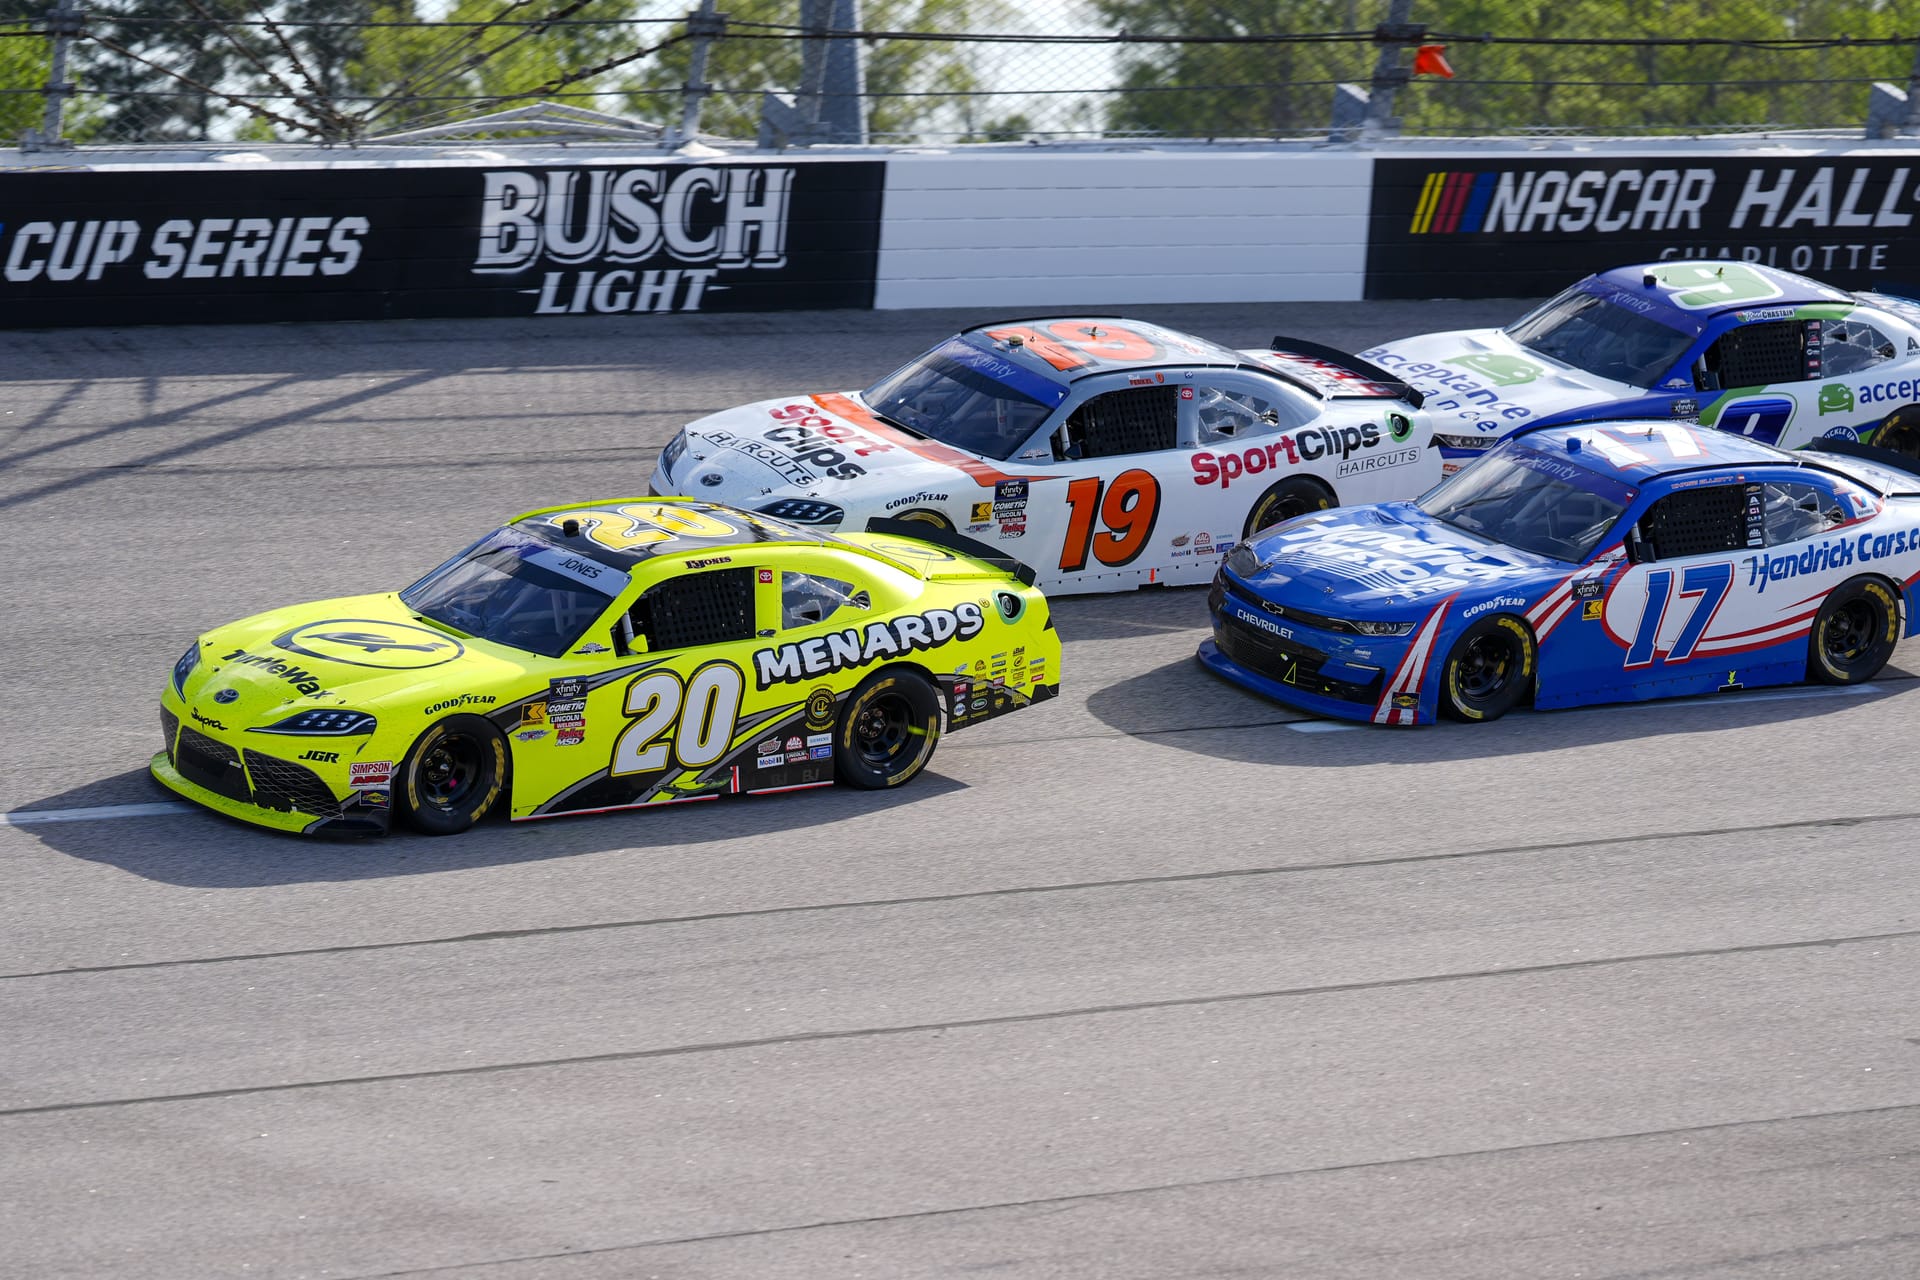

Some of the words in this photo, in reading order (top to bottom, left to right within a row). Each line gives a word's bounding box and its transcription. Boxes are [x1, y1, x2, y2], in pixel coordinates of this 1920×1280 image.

[1483, 167, 1715, 233] NASCAR
[1730, 167, 1914, 229] HALL
[471, 167, 796, 274] BUSCH
[4, 219, 140, 282] CUP
[143, 216, 370, 279] SERIES
[534, 269, 718, 314] LIGHT
[985, 320, 1169, 373] 19
[970, 353, 1017, 378] xfinity
[768, 404, 899, 458] Sport
[709, 432, 816, 486] HAIRCUTS
[763, 426, 868, 481] Clips
[1564, 423, 1710, 471] 17
[1338, 449, 1418, 476] HAIRCUTS
[1531, 455, 1582, 480] xfinity
[885, 492, 949, 510] GOODYEAR
[1000, 485, 1024, 497] xfinity
[994, 500, 1027, 510] COMETIC
[996, 511, 1022, 519] LINCOLN
[547, 504, 739, 552] 20
[1059, 468, 1162, 573] 19
[1857, 528, 1920, 562] Cars.c
[558, 558, 603, 580] JONES
[1749, 537, 1855, 593] Hendrick
[1576, 584, 1600, 597] xfinity
[1463, 595, 1526, 619] GOODYEAR
[1624, 560, 1735, 672] 17
[1236, 609, 1295, 640] CHEVROLET
[754, 603, 984, 691] MENARDS
[555, 684, 581, 696] xfinity
[424, 693, 497, 716] GOODYEAR
[548, 702, 585, 713] COMETIC
[191, 707, 229, 731] Supra
[551, 714, 580, 723] LINCOLN
[610, 660, 745, 778] 20
[555, 738, 580, 747] MSD
[298, 750, 340, 764] JGR
[351, 762, 391, 774] SIMPSON
[760, 757, 776, 766] Mobil
